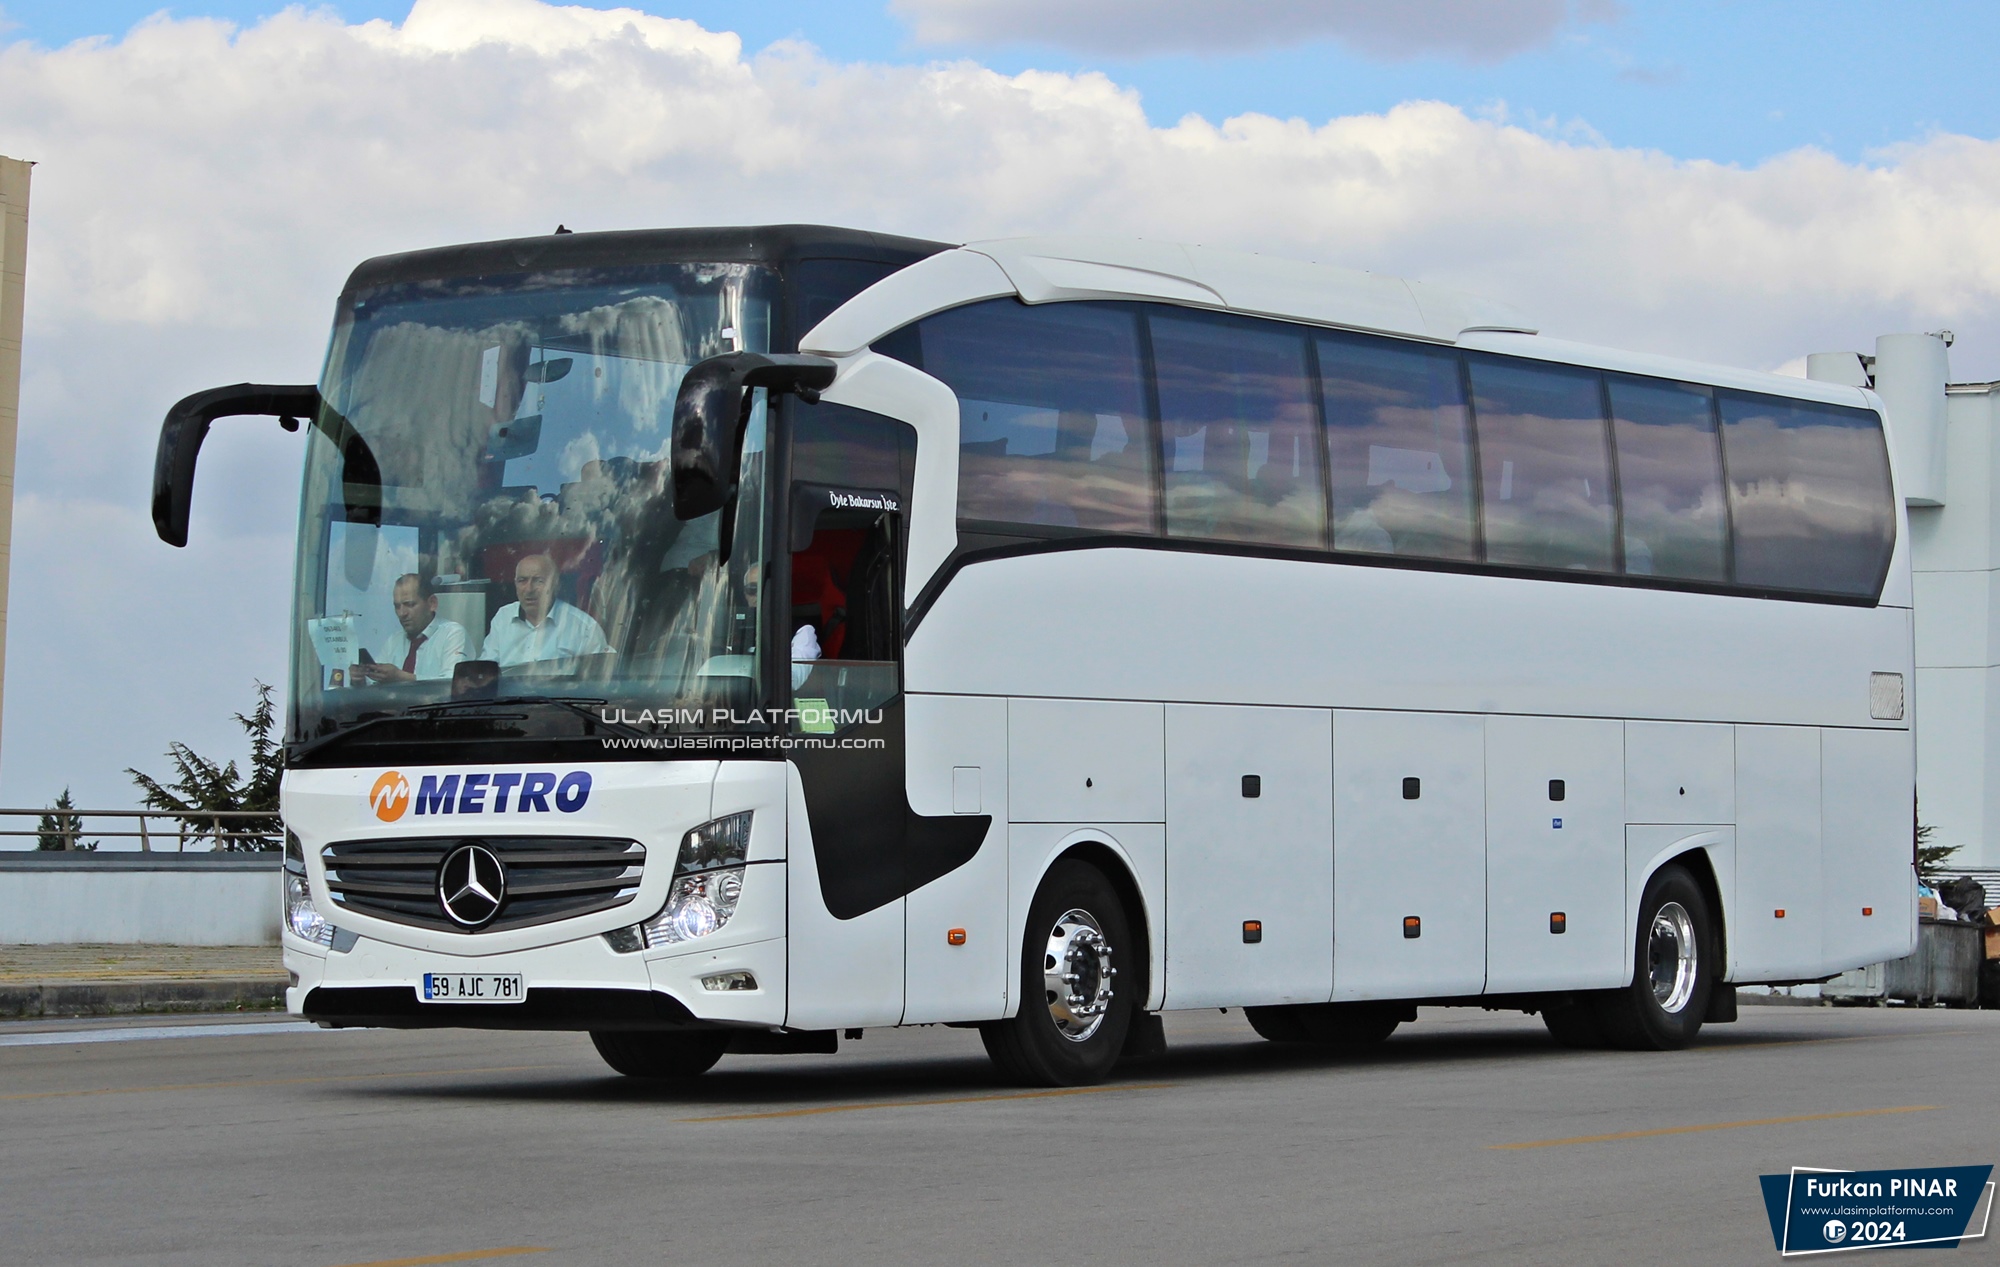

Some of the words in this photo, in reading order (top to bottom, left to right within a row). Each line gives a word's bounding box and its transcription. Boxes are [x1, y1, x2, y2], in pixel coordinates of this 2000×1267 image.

[829, 490, 848, 509] Öyle
[848, 494, 883, 509] Bakarsın
[414, 770, 593, 816] METRO
[433, 977, 449, 997] 59
[458, 977, 484, 997] AJC
[493, 977, 518, 997] 781
